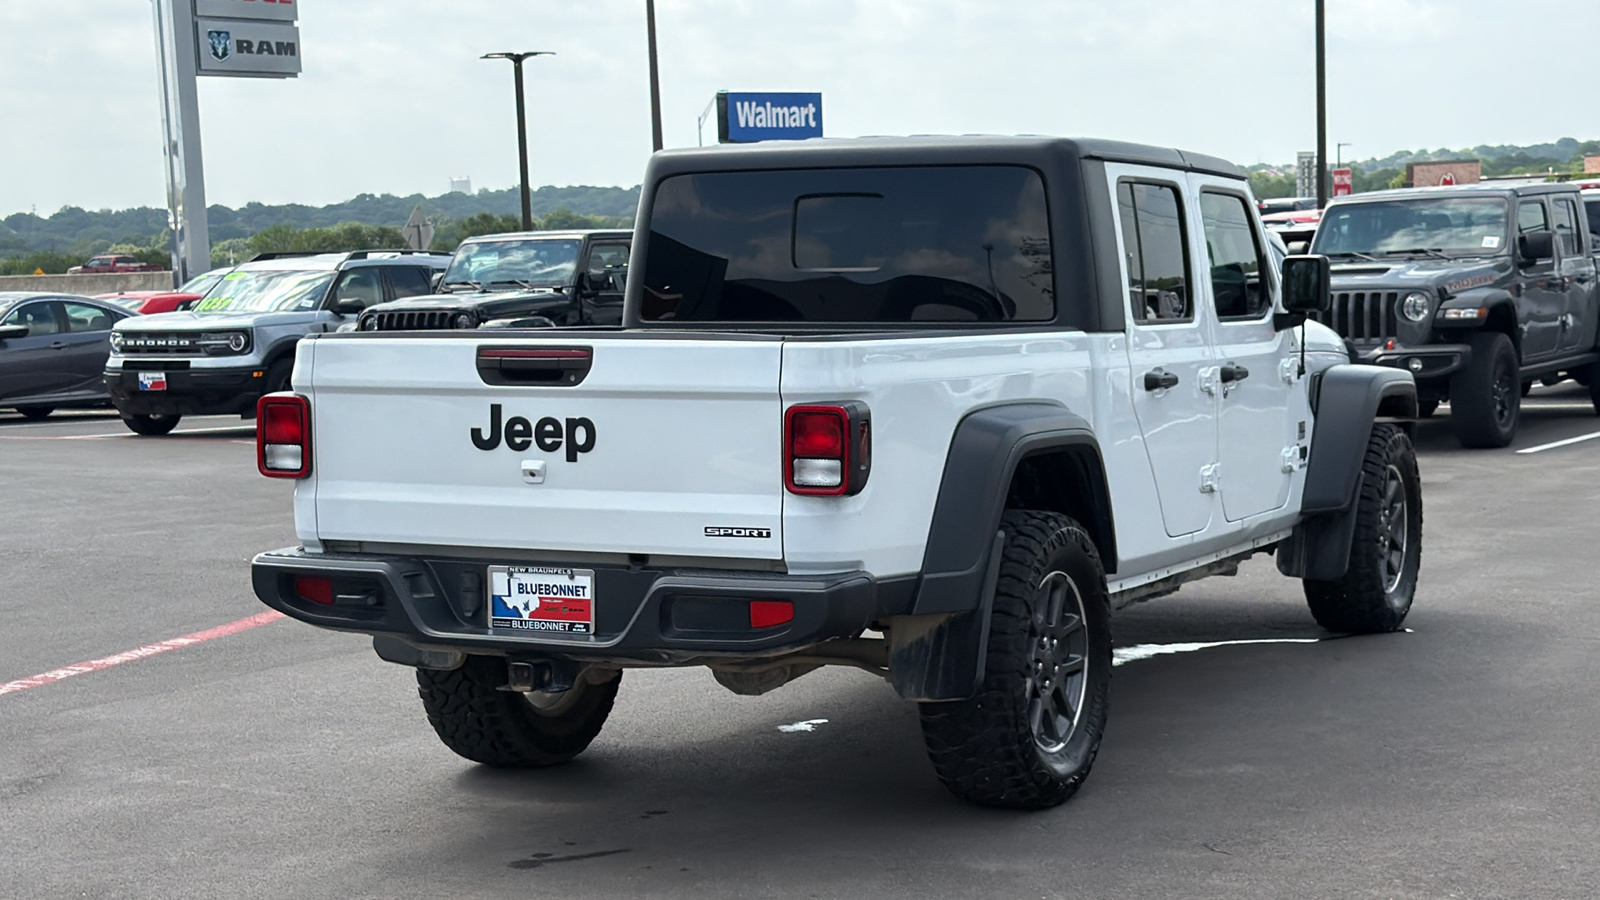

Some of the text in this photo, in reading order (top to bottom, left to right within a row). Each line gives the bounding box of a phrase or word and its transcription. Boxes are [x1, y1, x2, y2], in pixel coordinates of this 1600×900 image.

[236, 39, 296, 56] RAM
[736, 101, 817, 128] Walmart
[470, 403, 597, 463] Jeep
[704, 527, 771, 537] SPORT
[517, 583, 587, 597] BLUEBONNET
[511, 620, 570, 631] BLUEBONNET
